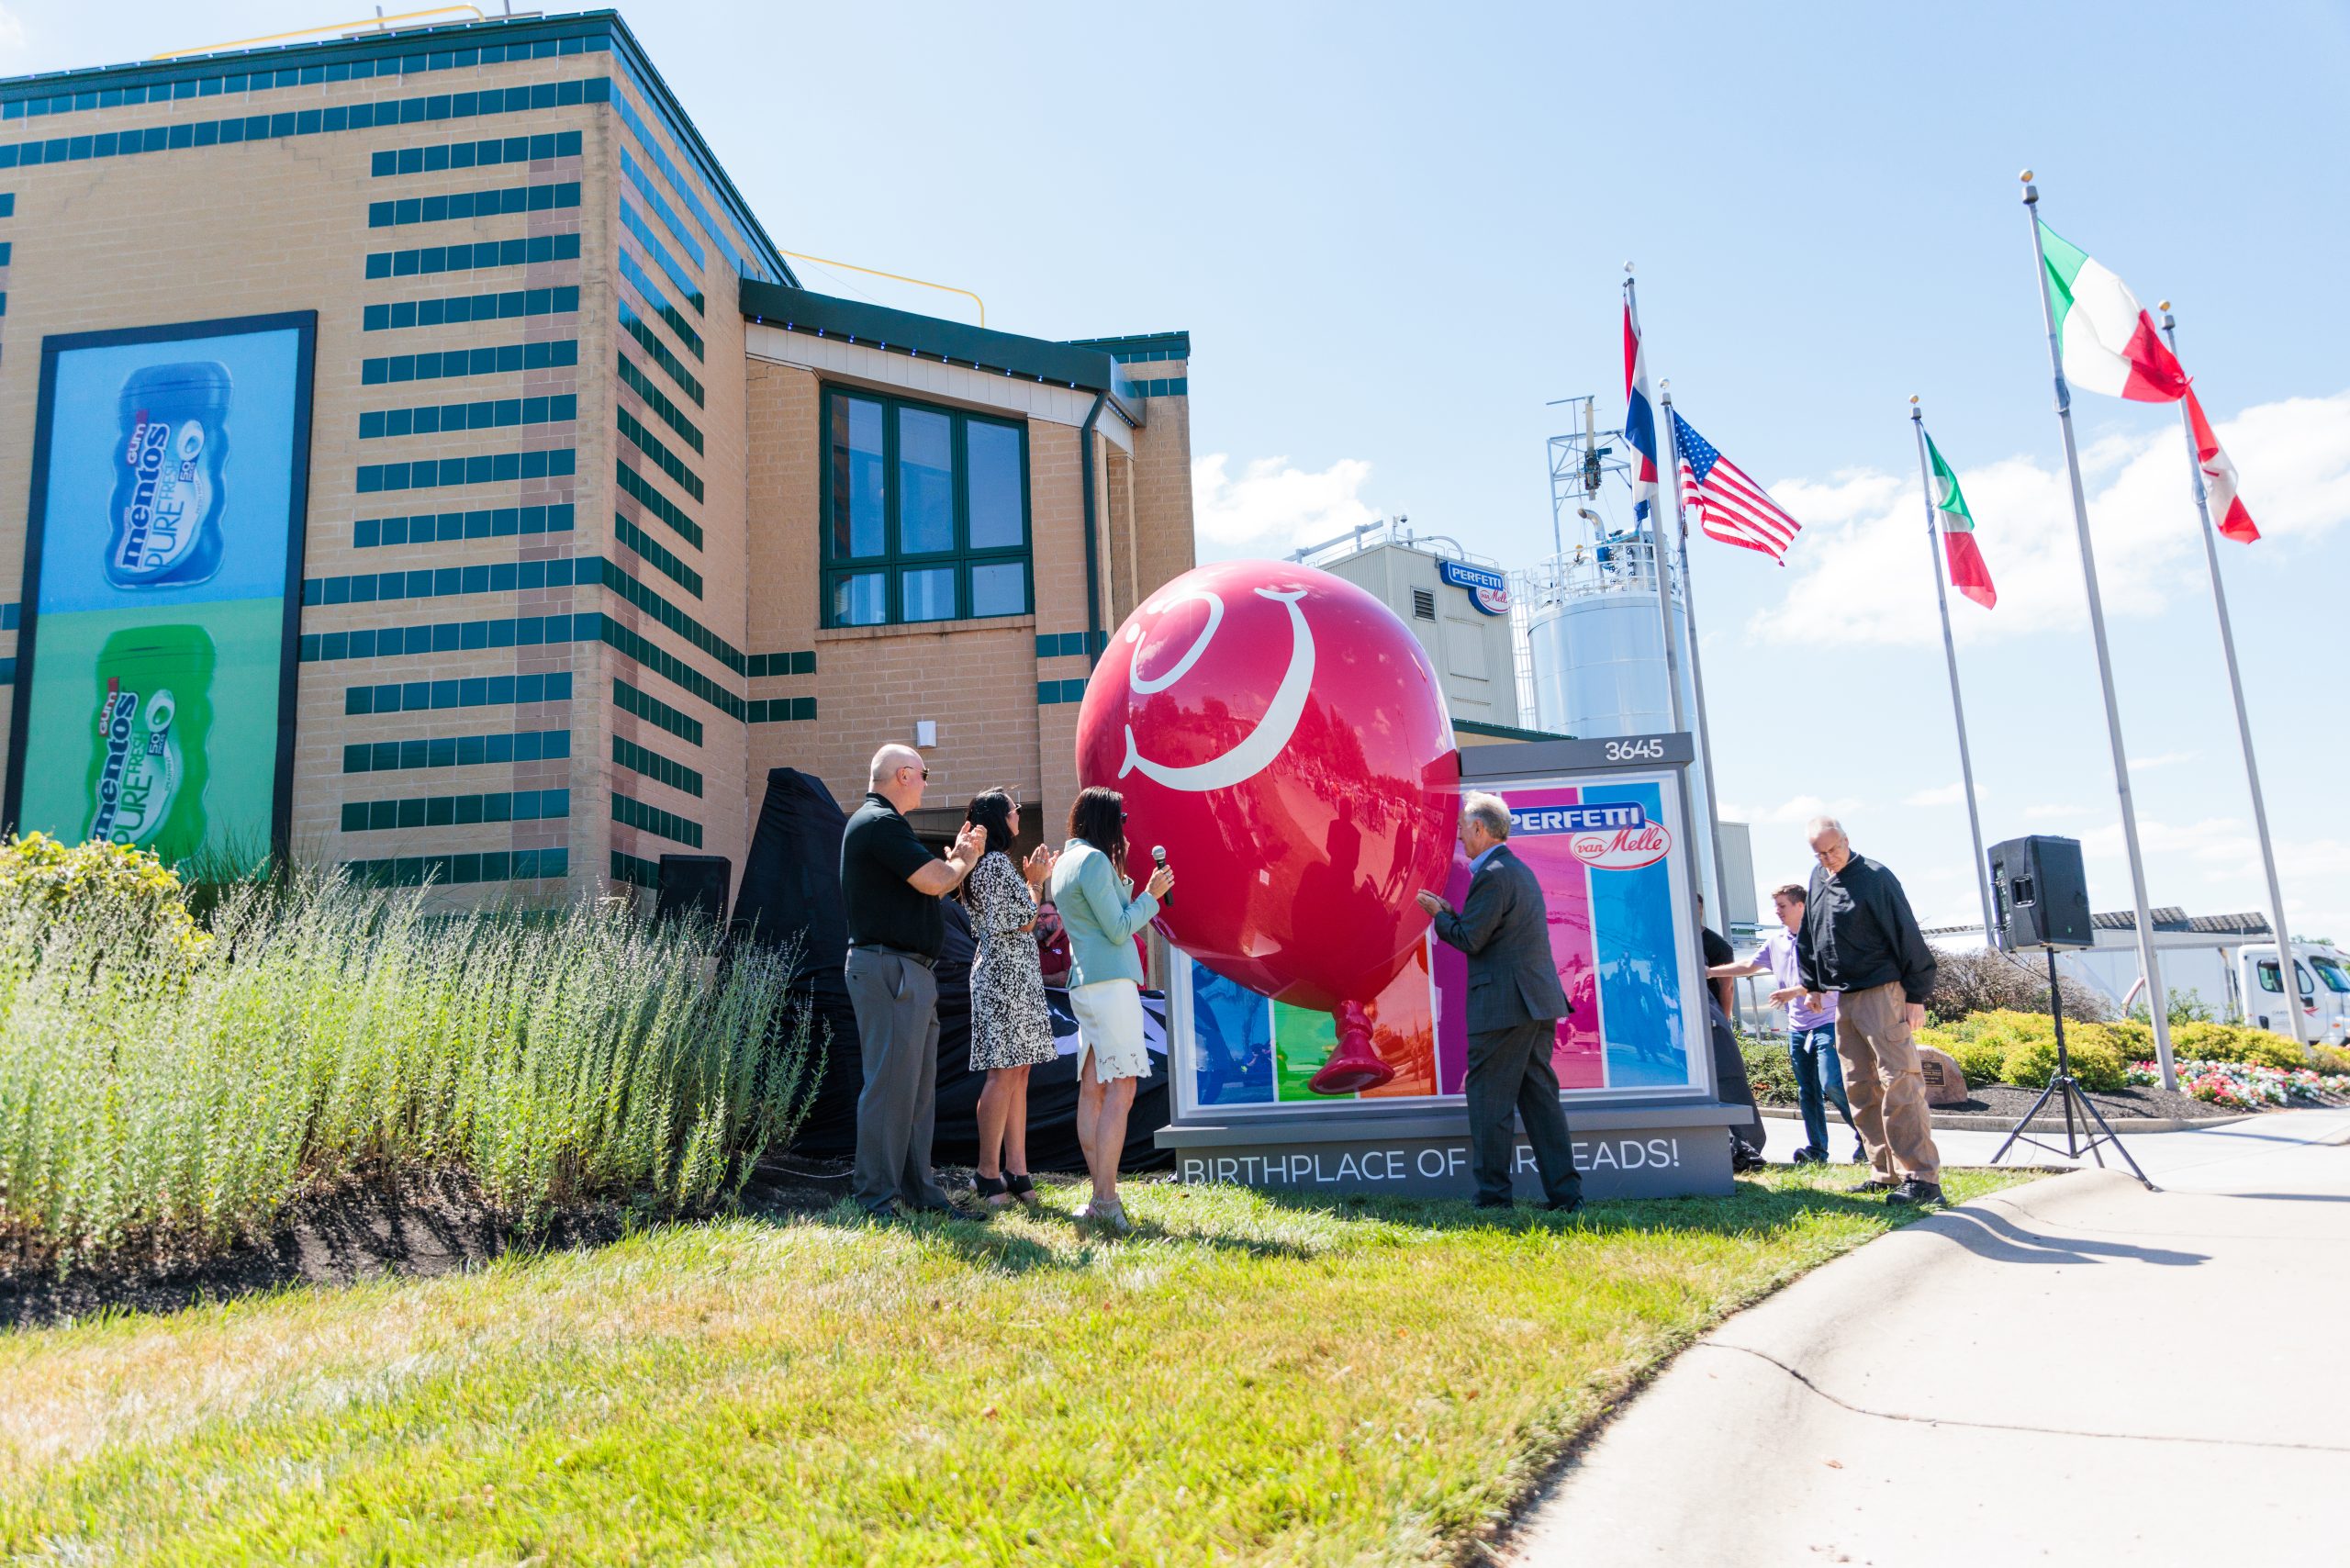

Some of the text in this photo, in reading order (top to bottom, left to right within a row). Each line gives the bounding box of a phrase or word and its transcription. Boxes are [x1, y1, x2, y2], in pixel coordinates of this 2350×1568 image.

[180, 461, 191, 480] 50
[122, 424, 169, 567] mentos
[144, 459, 185, 568] PURE FRESH
[1452, 567, 1502, 588] PERFETTI
[1492, 588, 1508, 603] Mell
[127, 732, 148, 774] FRESH
[149, 733, 161, 753] 50
[1605, 738, 1664, 761] 3645
[93, 693, 138, 842] mentos
[1577, 823, 1662, 854] van Melle
[1184, 1138, 1680, 1185] BIRTHPLACE OF READS!
